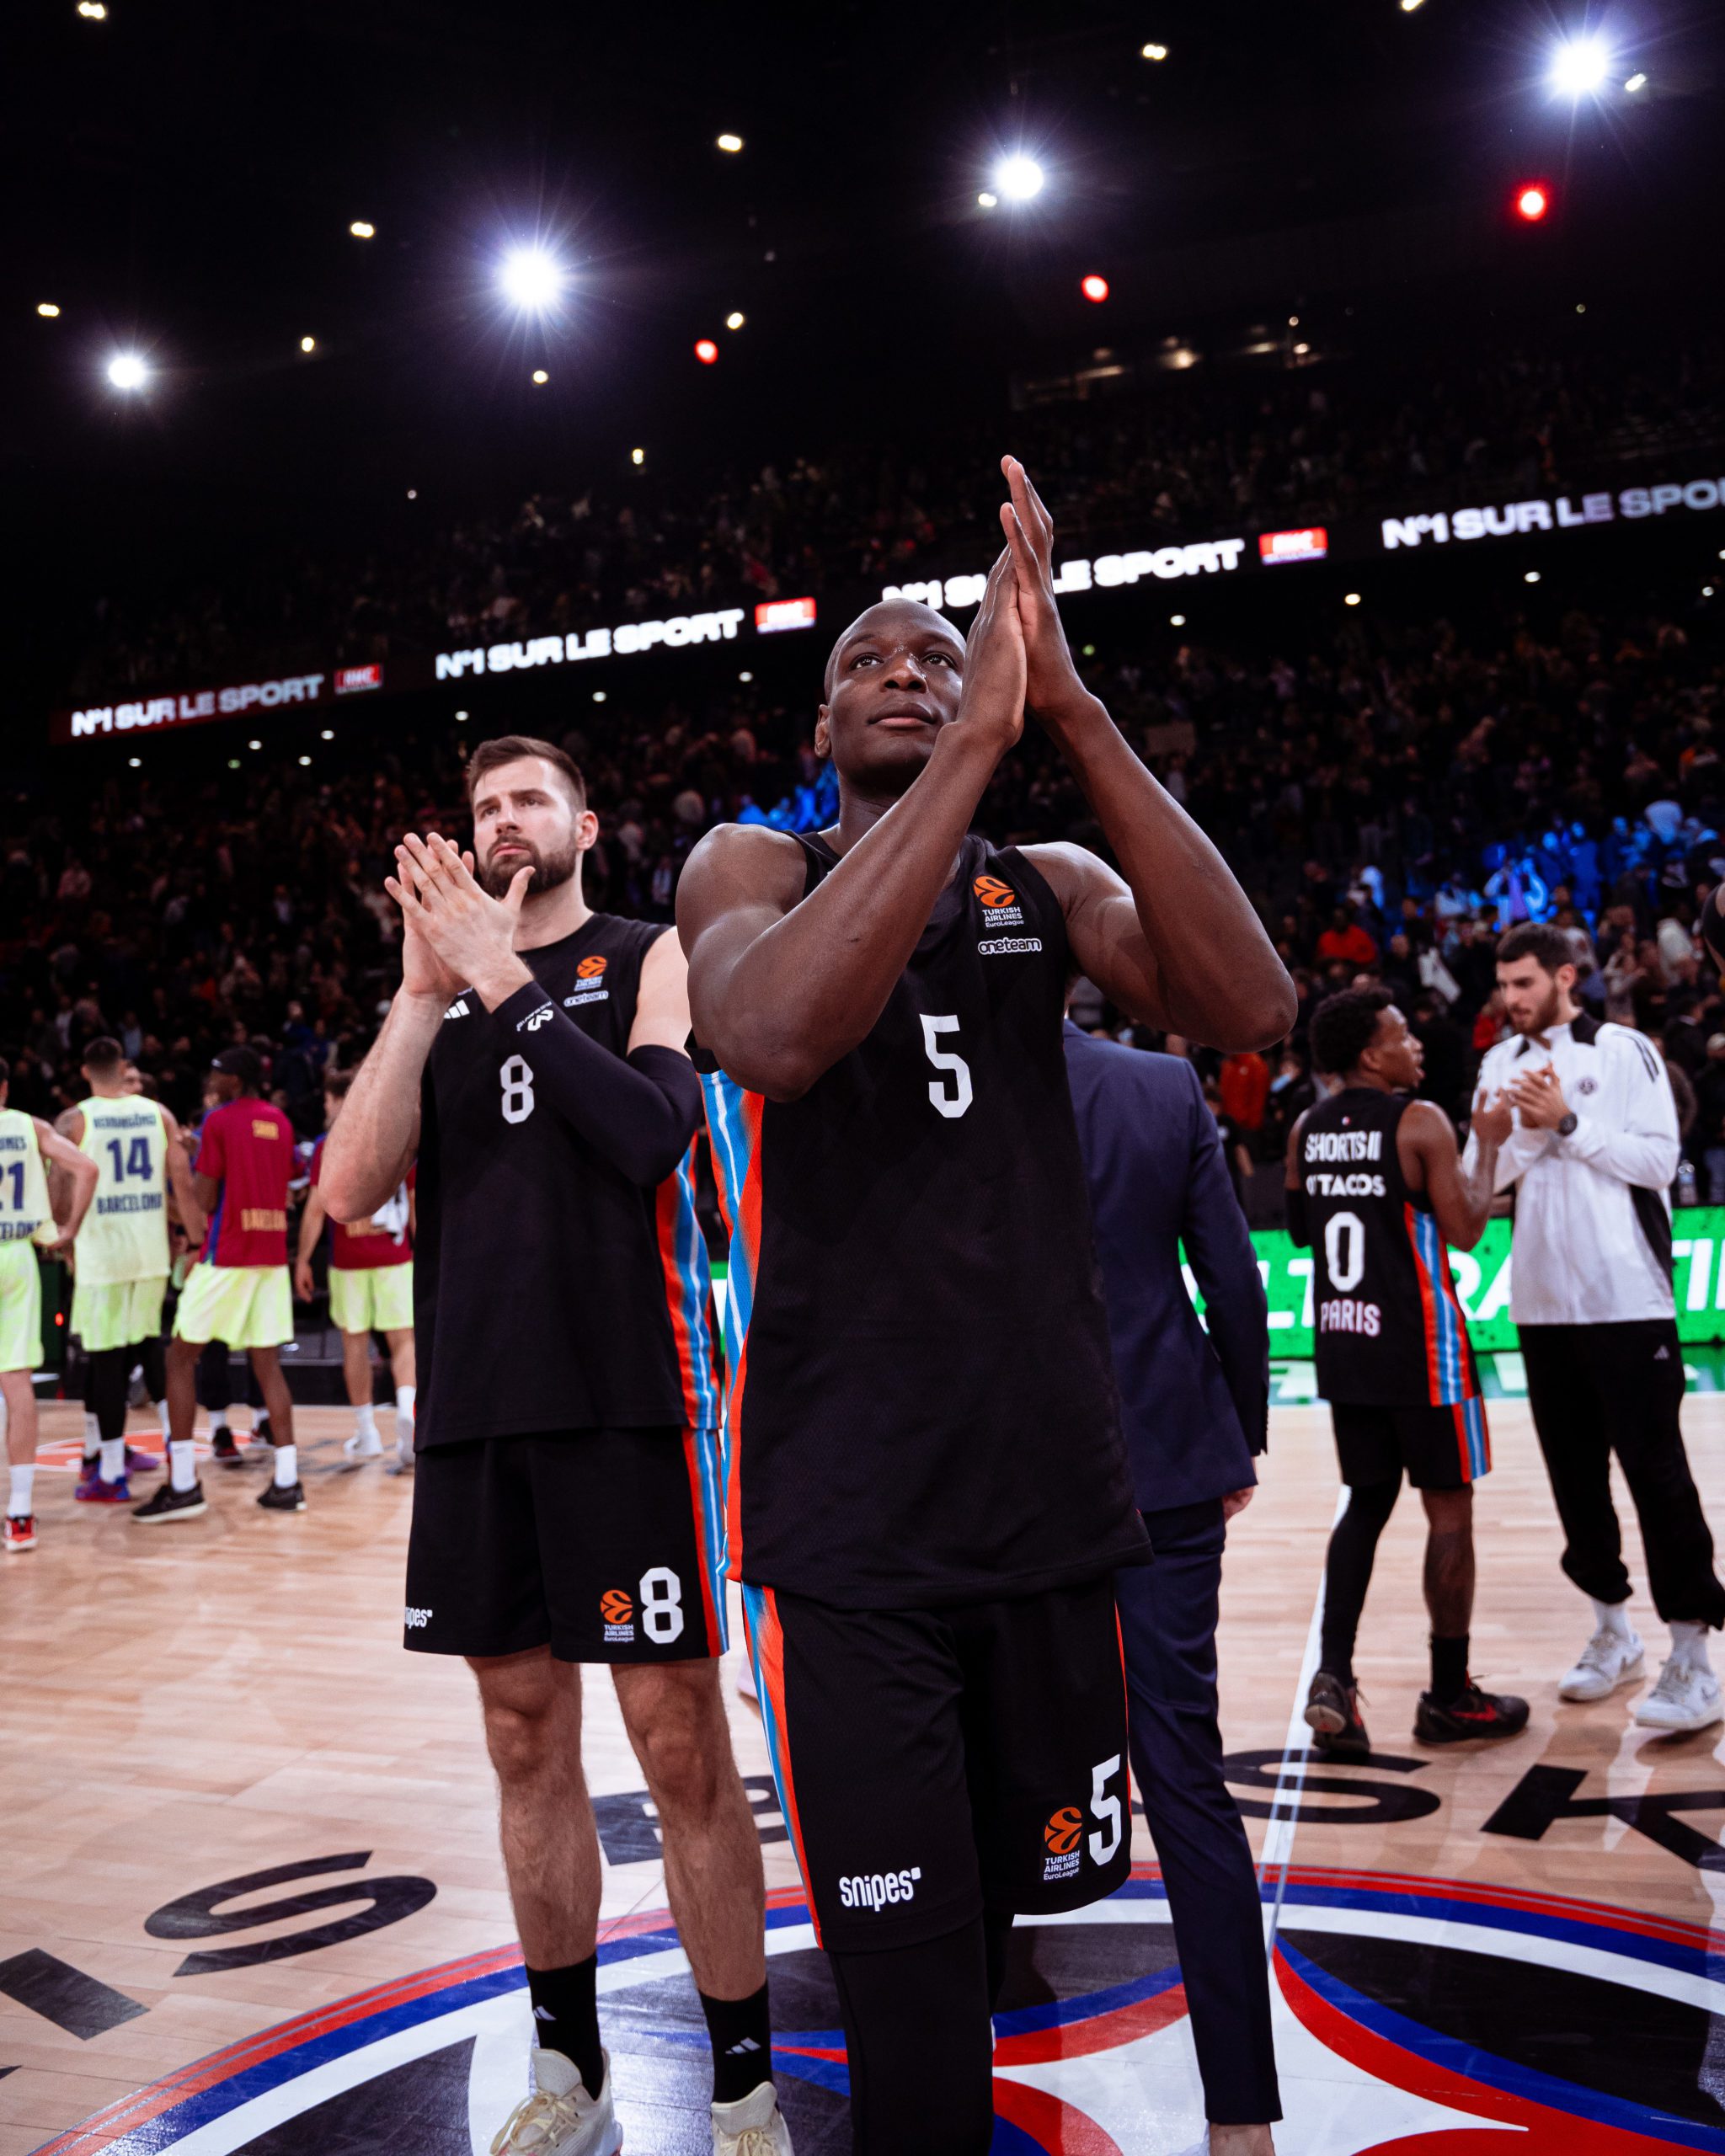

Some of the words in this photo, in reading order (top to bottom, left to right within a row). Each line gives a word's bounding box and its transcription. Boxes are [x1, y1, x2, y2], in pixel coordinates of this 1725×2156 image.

[1451, 500, 1552, 540] SUR
[1556, 492, 1614, 527] LE
[1093, 538, 1245, 587] SPORT
[487, 637, 564, 673] SUR
[565, 627, 612, 661] LE
[612, 608, 745, 654] SPORT
[114, 696, 176, 730] SUR
[179, 691, 215, 720] LE
[217, 674, 325, 714] SPORT
[982, 906, 1021, 915] TURKISH
[985, 913, 1023, 922] AIRLINES
[985, 920, 1025, 928] EuroLeague
[978, 937, 1043, 956] oneteam
[919, 1013, 974, 1118] 5
[499, 1054, 535, 1124] 8
[107, 1137, 153, 1183] 14
[1305, 1130, 1367, 1163] SHORTS
[0, 1161, 24, 1209] 1
[1324, 1211, 1365, 1293] 0
[1320, 1299, 1382, 1338] PARIS
[639, 1566, 684, 1645] 8
[1088, 1753, 1122, 1867] 5
[1043, 1866, 1080, 1881] EuroLeague
[1044, 1849, 1080, 1865] TURKISH
[1044, 1858, 1080, 1873] AIRLINES
[839, 1867, 922, 1913] snipes
